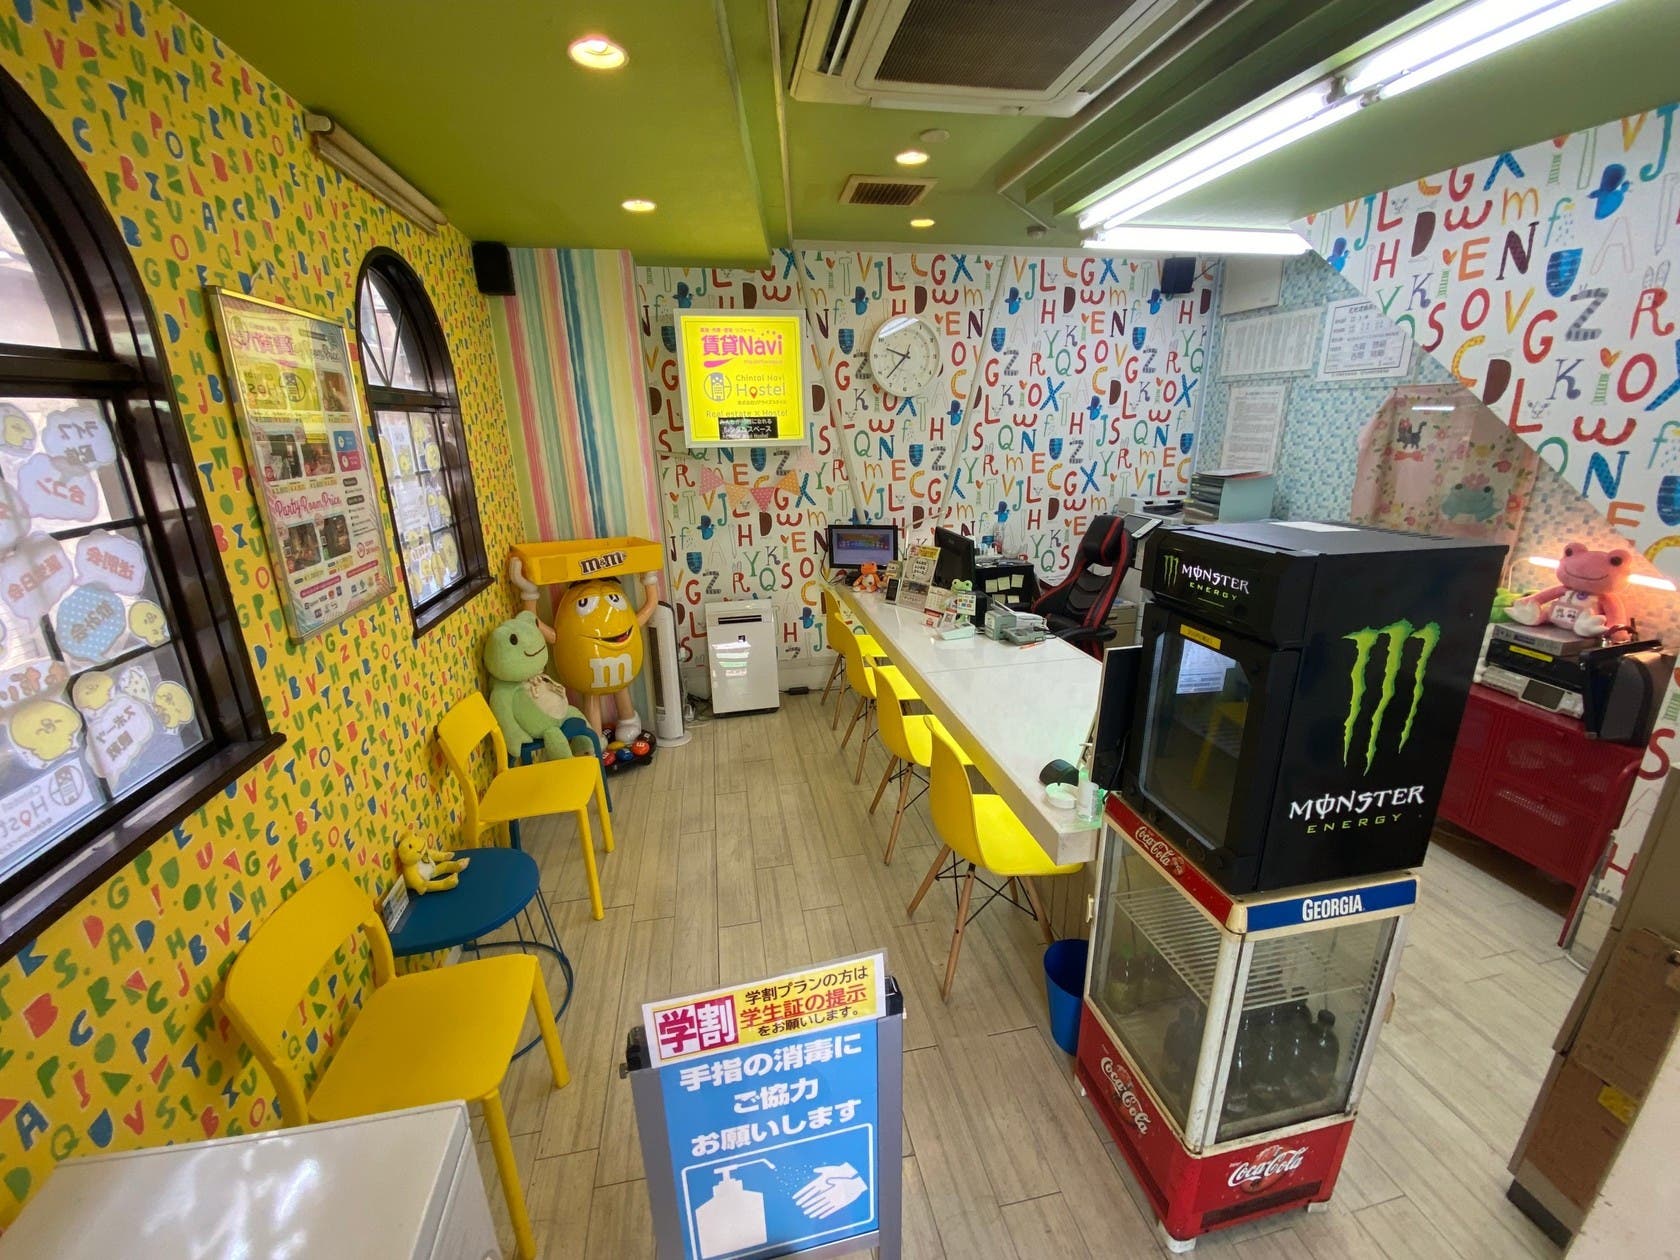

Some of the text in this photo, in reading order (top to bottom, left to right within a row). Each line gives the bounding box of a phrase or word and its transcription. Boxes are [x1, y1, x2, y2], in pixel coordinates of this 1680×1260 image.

[702, 334, 783, 356] 賃貸Navi
[736, 383, 786, 399] Hostel
[322, 492, 342, 509] Price
[1190, 582, 1238, 600] ENERGY
[1306, 812, 1402, 834] ENERGY
[1302, 894, 1363, 922] GEORGIA
[745, 966, 868, 1005] 学割プランの方は
[740, 984, 868, 1026] 学生証の提示
[658, 1000, 737, 1053] 学割
[758, 1006, 859, 1036] をお願いします。
[680, 1033, 862, 1092] 手指の消毒に
[734, 1077, 818, 1114] ご協力
[692, 1099, 861, 1157] お願いします
